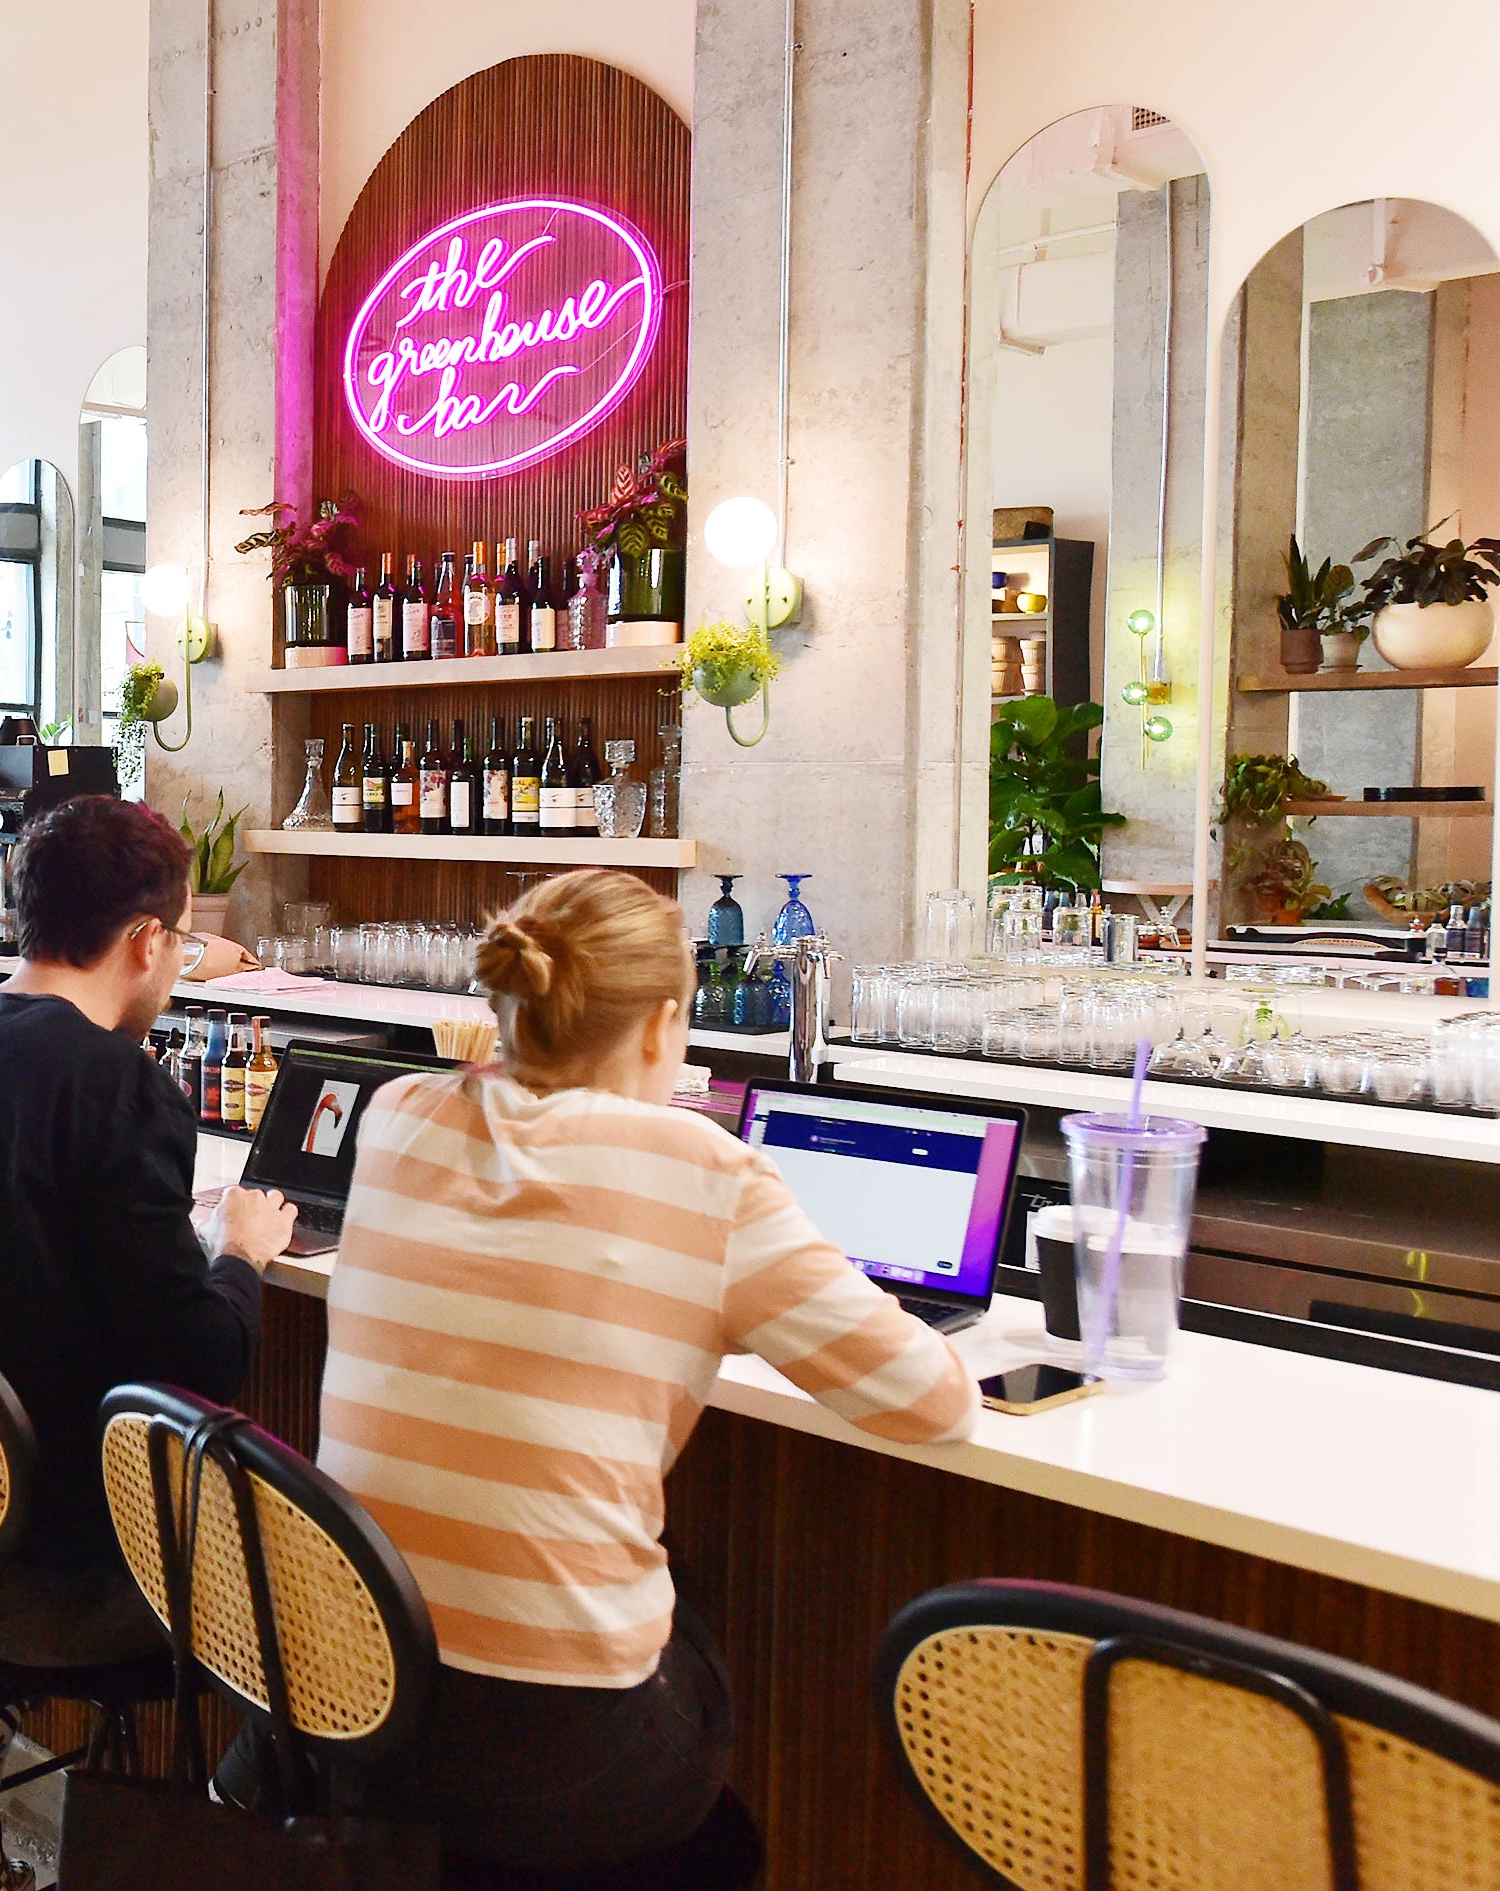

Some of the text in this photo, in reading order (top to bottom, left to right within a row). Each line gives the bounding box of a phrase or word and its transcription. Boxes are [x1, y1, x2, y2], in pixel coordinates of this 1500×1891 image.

[397, 236, 556, 329] the
[368, 277, 646, 433] greenhouse
[398, 366, 581, 438] bar
